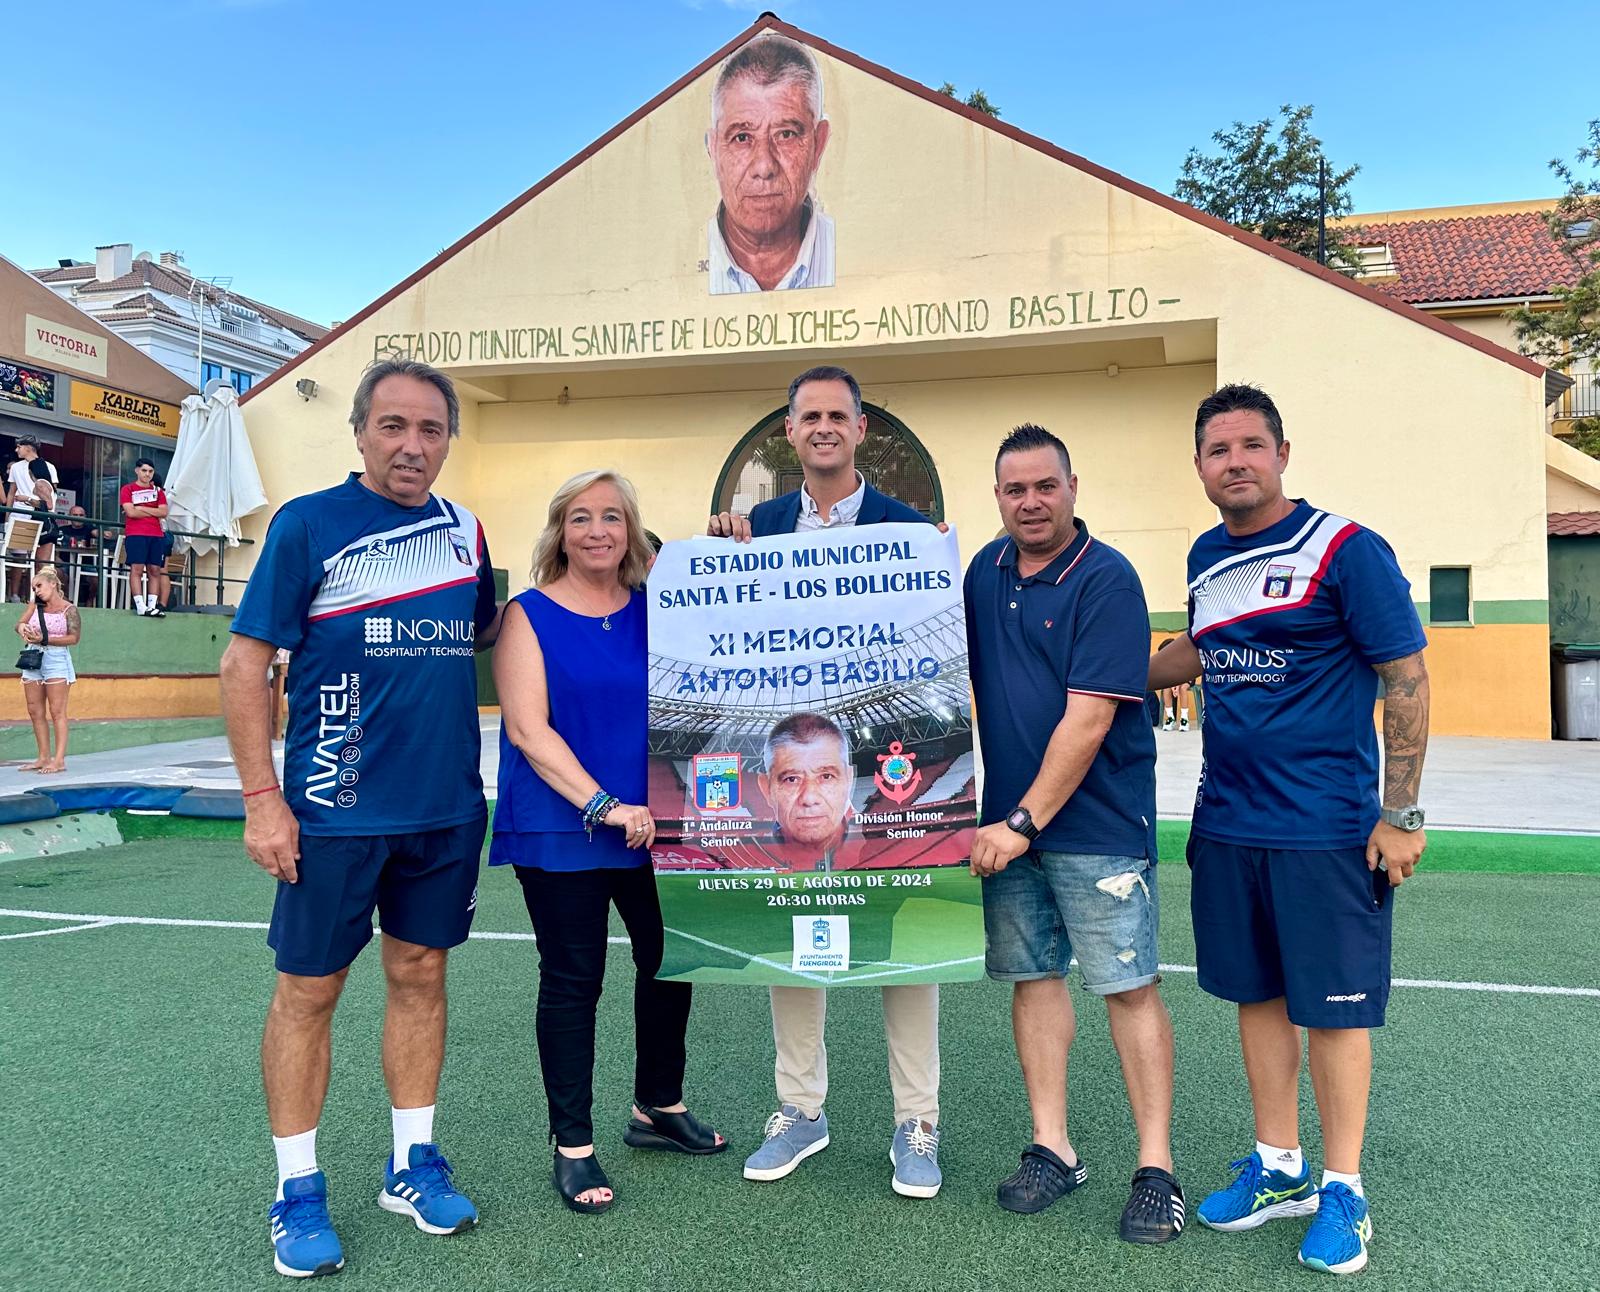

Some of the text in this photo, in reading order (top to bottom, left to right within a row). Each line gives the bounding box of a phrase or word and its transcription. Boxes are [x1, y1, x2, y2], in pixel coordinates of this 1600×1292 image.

[374, 331, 461, 362] ESTADIO
[469, 327, 570, 360] MUNICIPAL
[671, 318, 695, 350] DE
[703, 316, 741, 349] LOS
[1009, 287, 1148, 329] BASILIO
[36, 328, 98, 357] VICTORIA
[94, 403, 125, 418] Estamos
[126, 410, 166, 428] Conectados
[101, 391, 160, 419] KABLER
[690, 541, 917, 576] ESTADIO MUNICIPAL
[659, 586, 728, 609] SANTA
[736, 579, 762, 603] FÉ
[784, 578, 827, 600] LOS
[836, 570, 951, 597] BOLICHES
[397, 618, 475, 642] NONIUS
[709, 622, 904, 656] XI MEMORIAL
[365, 646, 475, 657] HOSPITALITY TECHNOLOG
[677, 656, 941, 694] ANTONIO BASILIO
[1227, 673, 1287, 683] TECHNOLOGY
[350, 672, 360, 723] TELECOM
[305, 672, 348, 808] AVATEL
[699, 820, 752, 832] Andaluza
[855, 812, 903, 825] División
[906, 811, 944, 822] Honor
[701, 837, 740, 848] Senior
[887, 828, 926, 840] Senior
[698, 873, 932, 891] JUEVES 29 DE AGOSTO DE 2024
[767, 894, 866, 906] 20:30 HORAS
